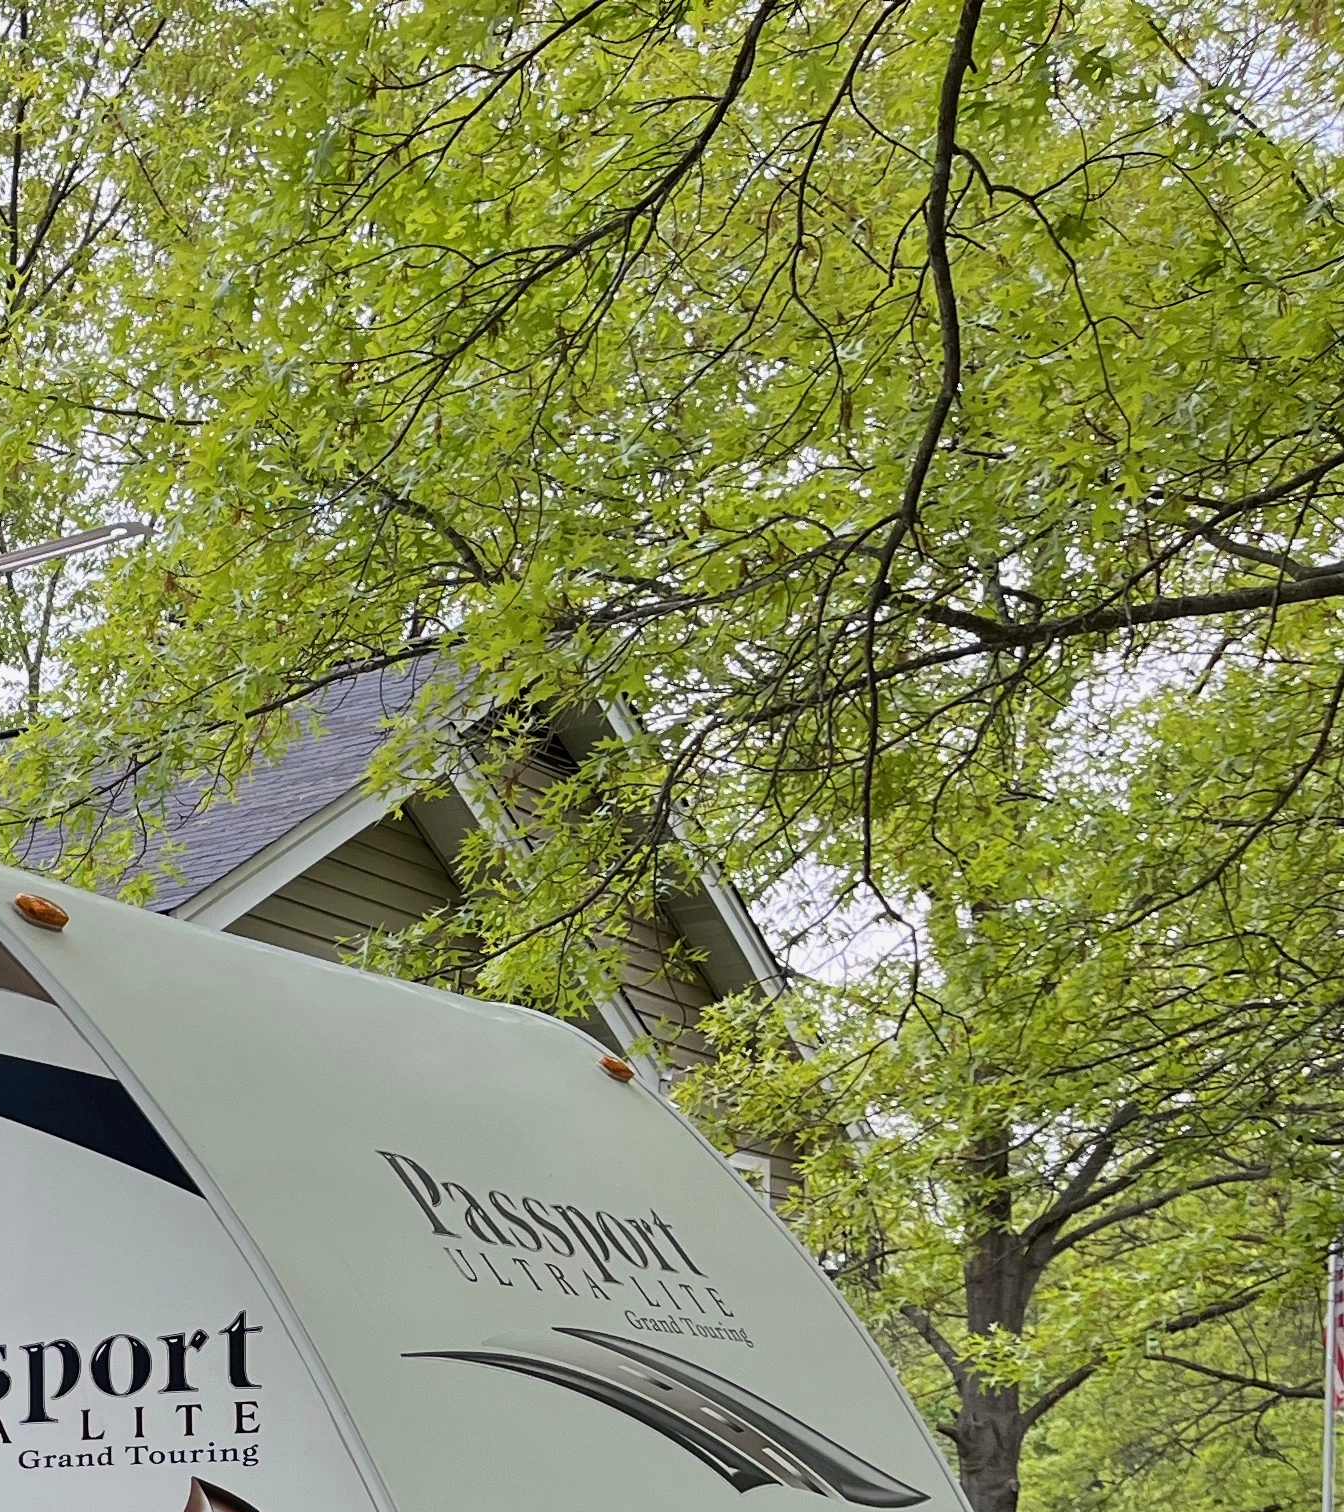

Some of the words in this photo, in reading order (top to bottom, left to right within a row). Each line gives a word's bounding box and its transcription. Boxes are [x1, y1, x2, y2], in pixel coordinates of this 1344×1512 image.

[375, 1149, 709, 1285] Passport
[443, 1247, 610, 1301] ULTRA
[630, 1275, 734, 1318] LITE
[624, 1309, 683, 1336] Grand
[679, 1317, 755, 1348] Touring
[80, 1401, 261, 1442] LITE
[18, 1446, 114, 1470] Grand
[124, 1442, 260, 1468] Touring
